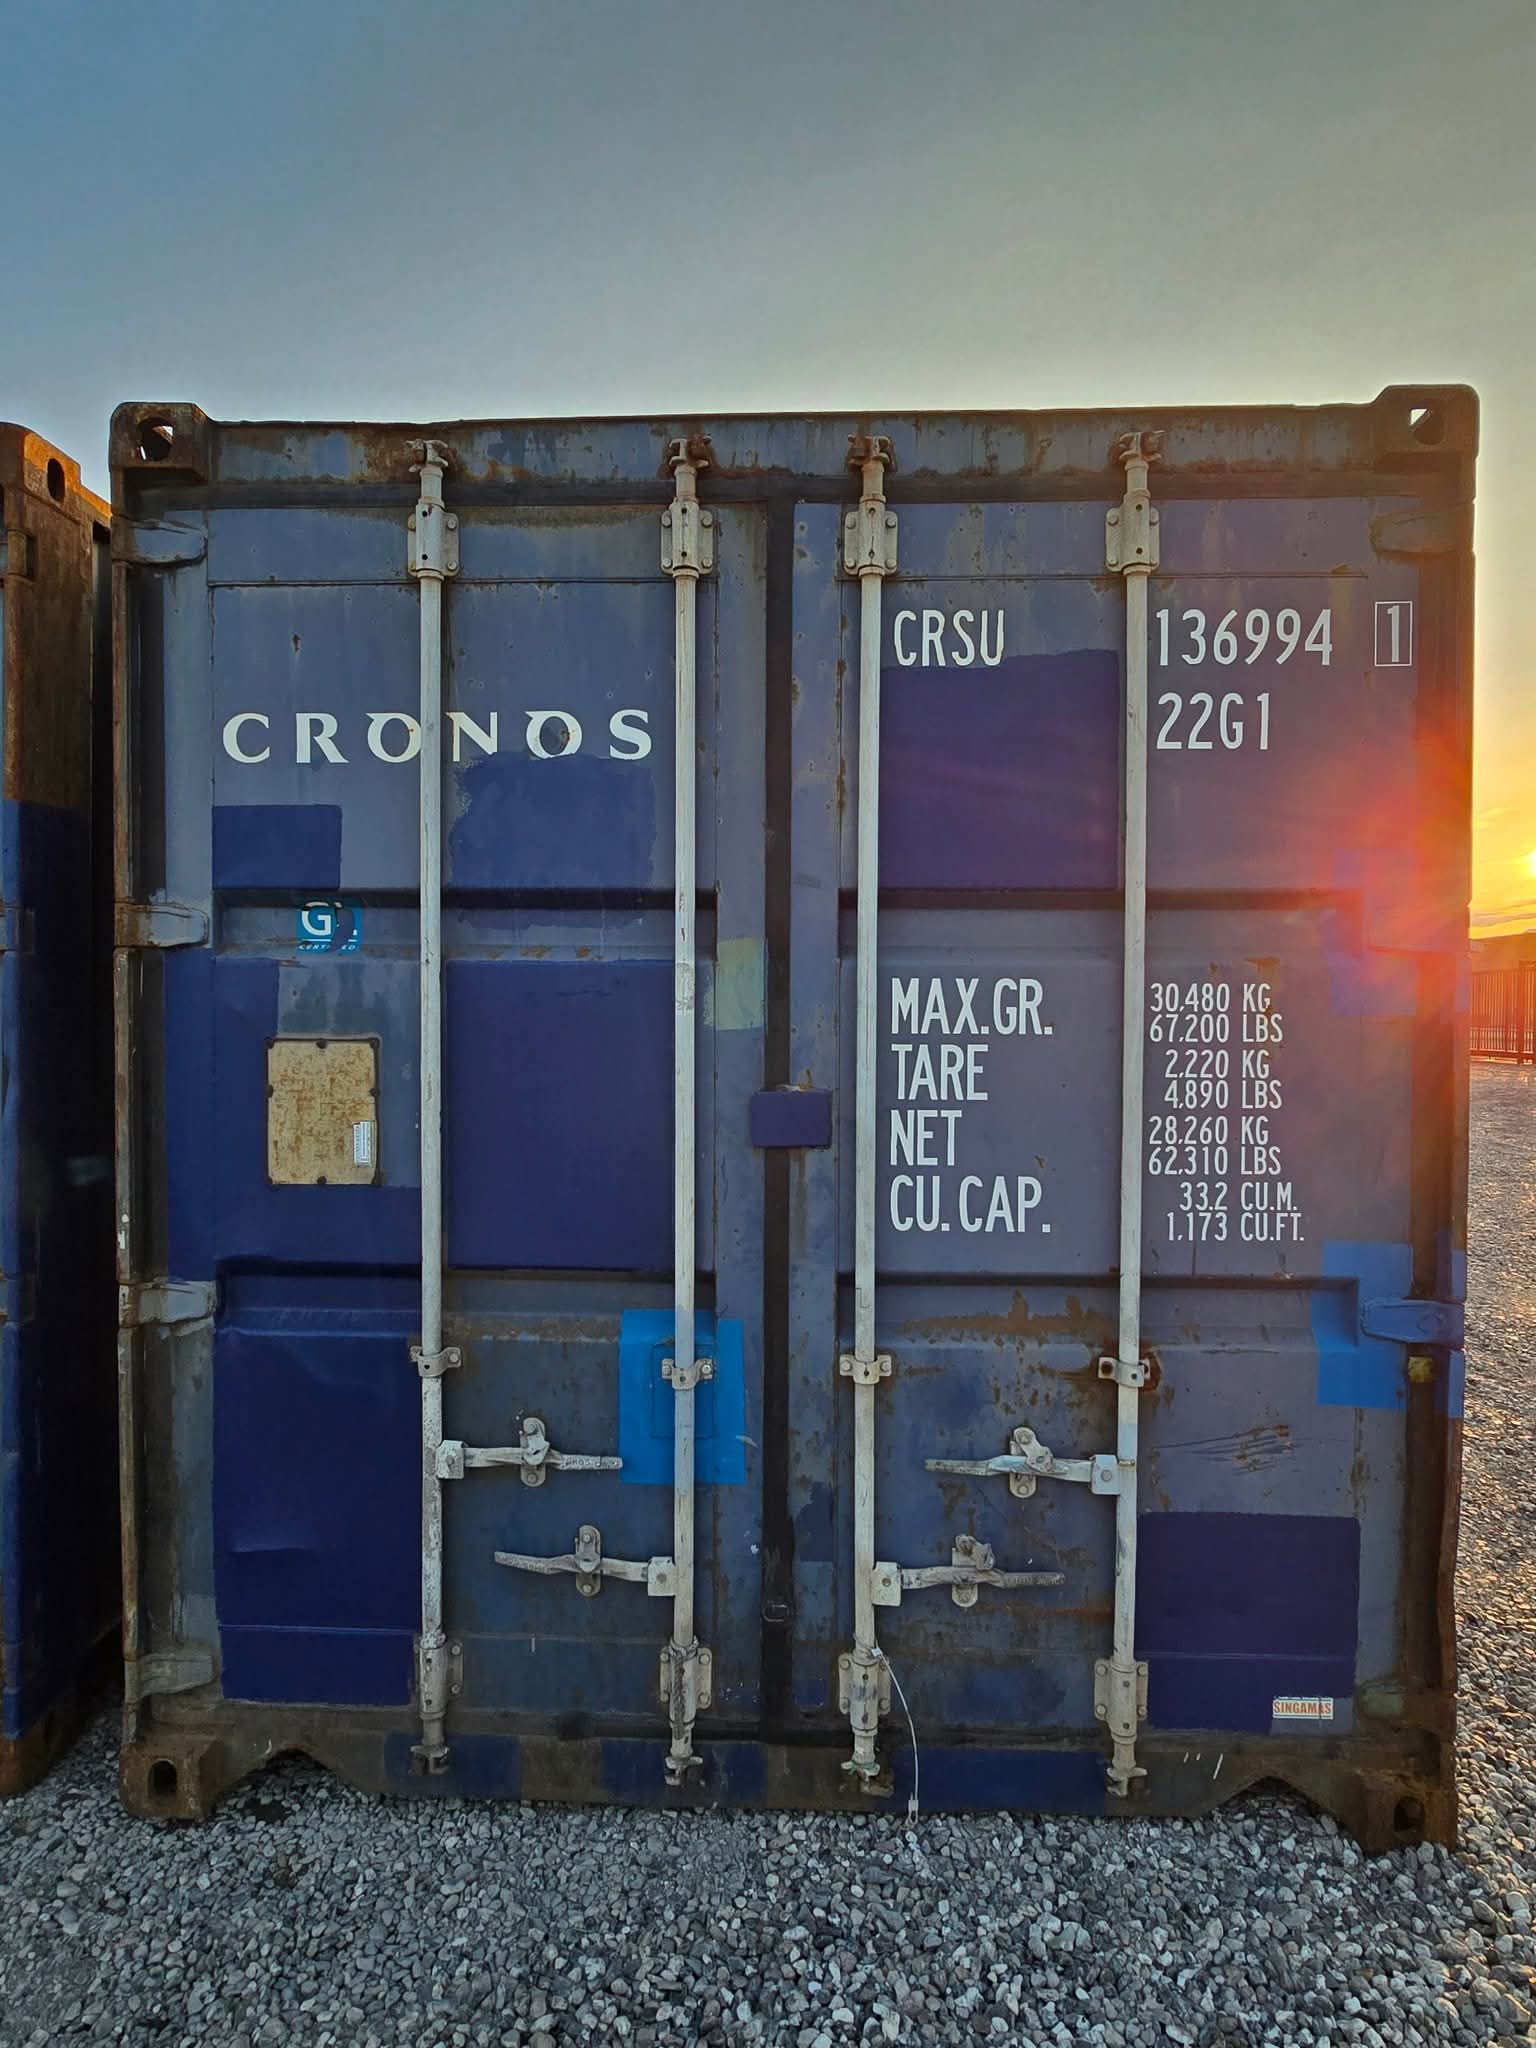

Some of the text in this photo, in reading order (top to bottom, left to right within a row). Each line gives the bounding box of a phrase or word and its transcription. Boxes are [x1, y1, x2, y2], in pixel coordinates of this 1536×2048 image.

[893, 604, 1400, 667] CRSU 136994 1
[222, 708, 653, 764] CRONOS
[1156, 692, 1270, 750] 22G1
[1150, 983, 1272, 1013] 30,480 KG
[1149, 1014, 1283, 1043] 67,200 LBS
[891, 1043, 989, 1101] TARE
[1164, 1049, 1270, 1079] 2,220 KG
[1164, 1080, 1283, 1110] 4,890 LBS
[890, 1109, 963, 1166] NET
[1148, 1115, 1269, 1146] 28,260 KG
[1148, 1146, 1282, 1176] 62,310 LBS
[1179, 1181, 1298, 1211] 33.2 CU.M.
[1166, 1212, 1305, 1242] 1,173 CU.FT.
[1273, 1701, 1332, 1715] SINGAMAS
